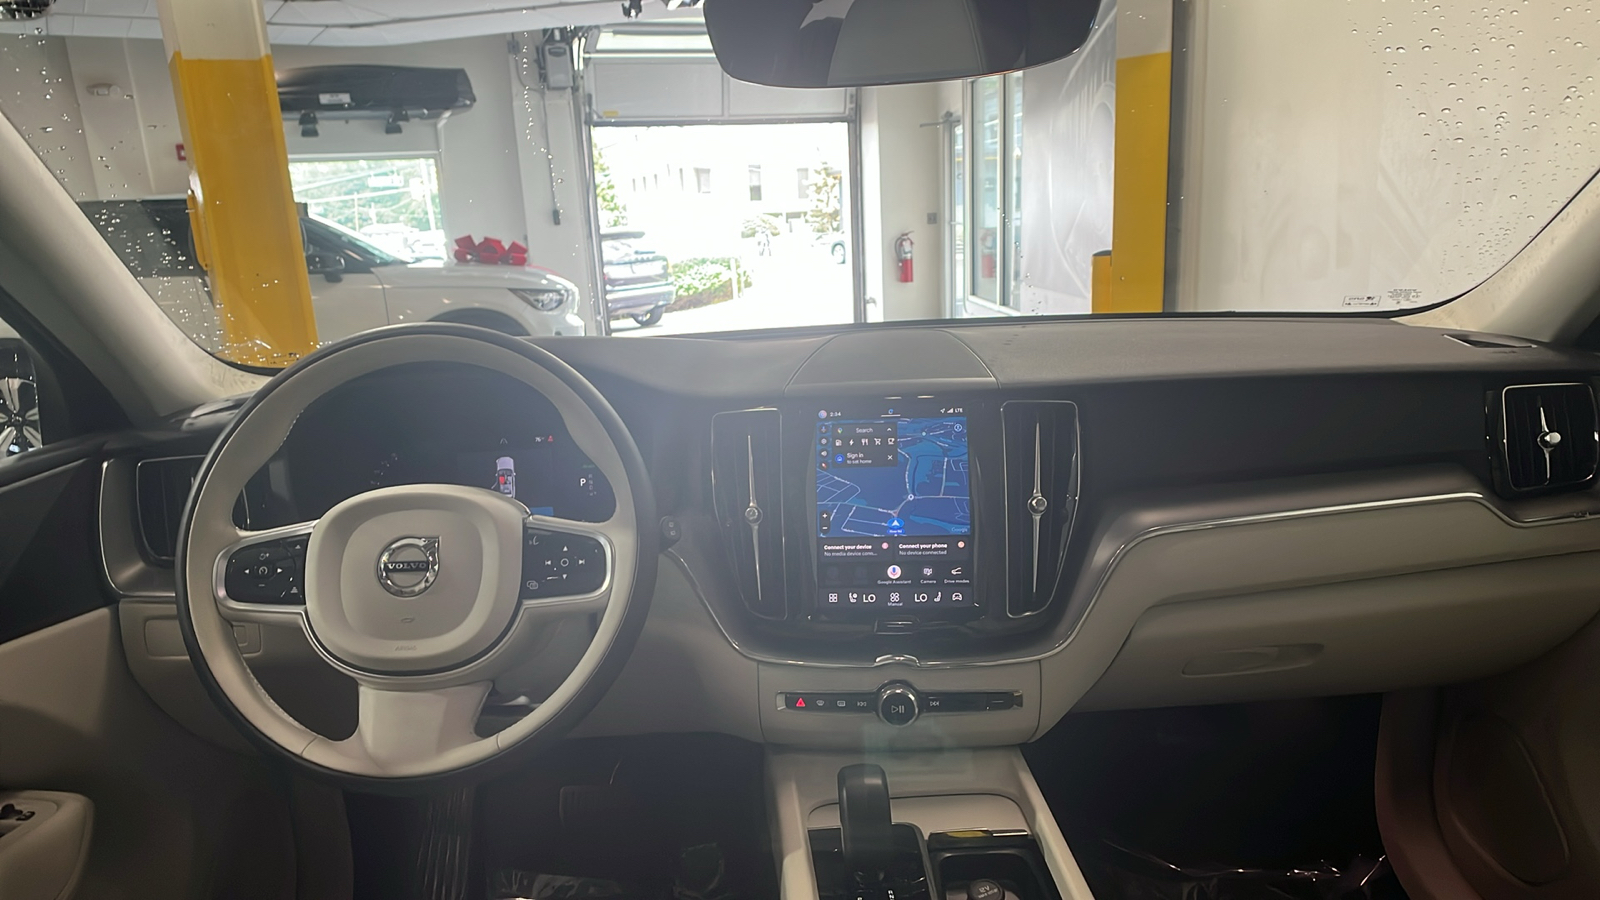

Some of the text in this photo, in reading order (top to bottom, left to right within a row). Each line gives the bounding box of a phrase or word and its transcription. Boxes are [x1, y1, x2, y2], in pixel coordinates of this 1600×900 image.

[580, 478, 586, 486] P
[863, 594, 876, 603] LO
[915, 594, 928, 602] LO
